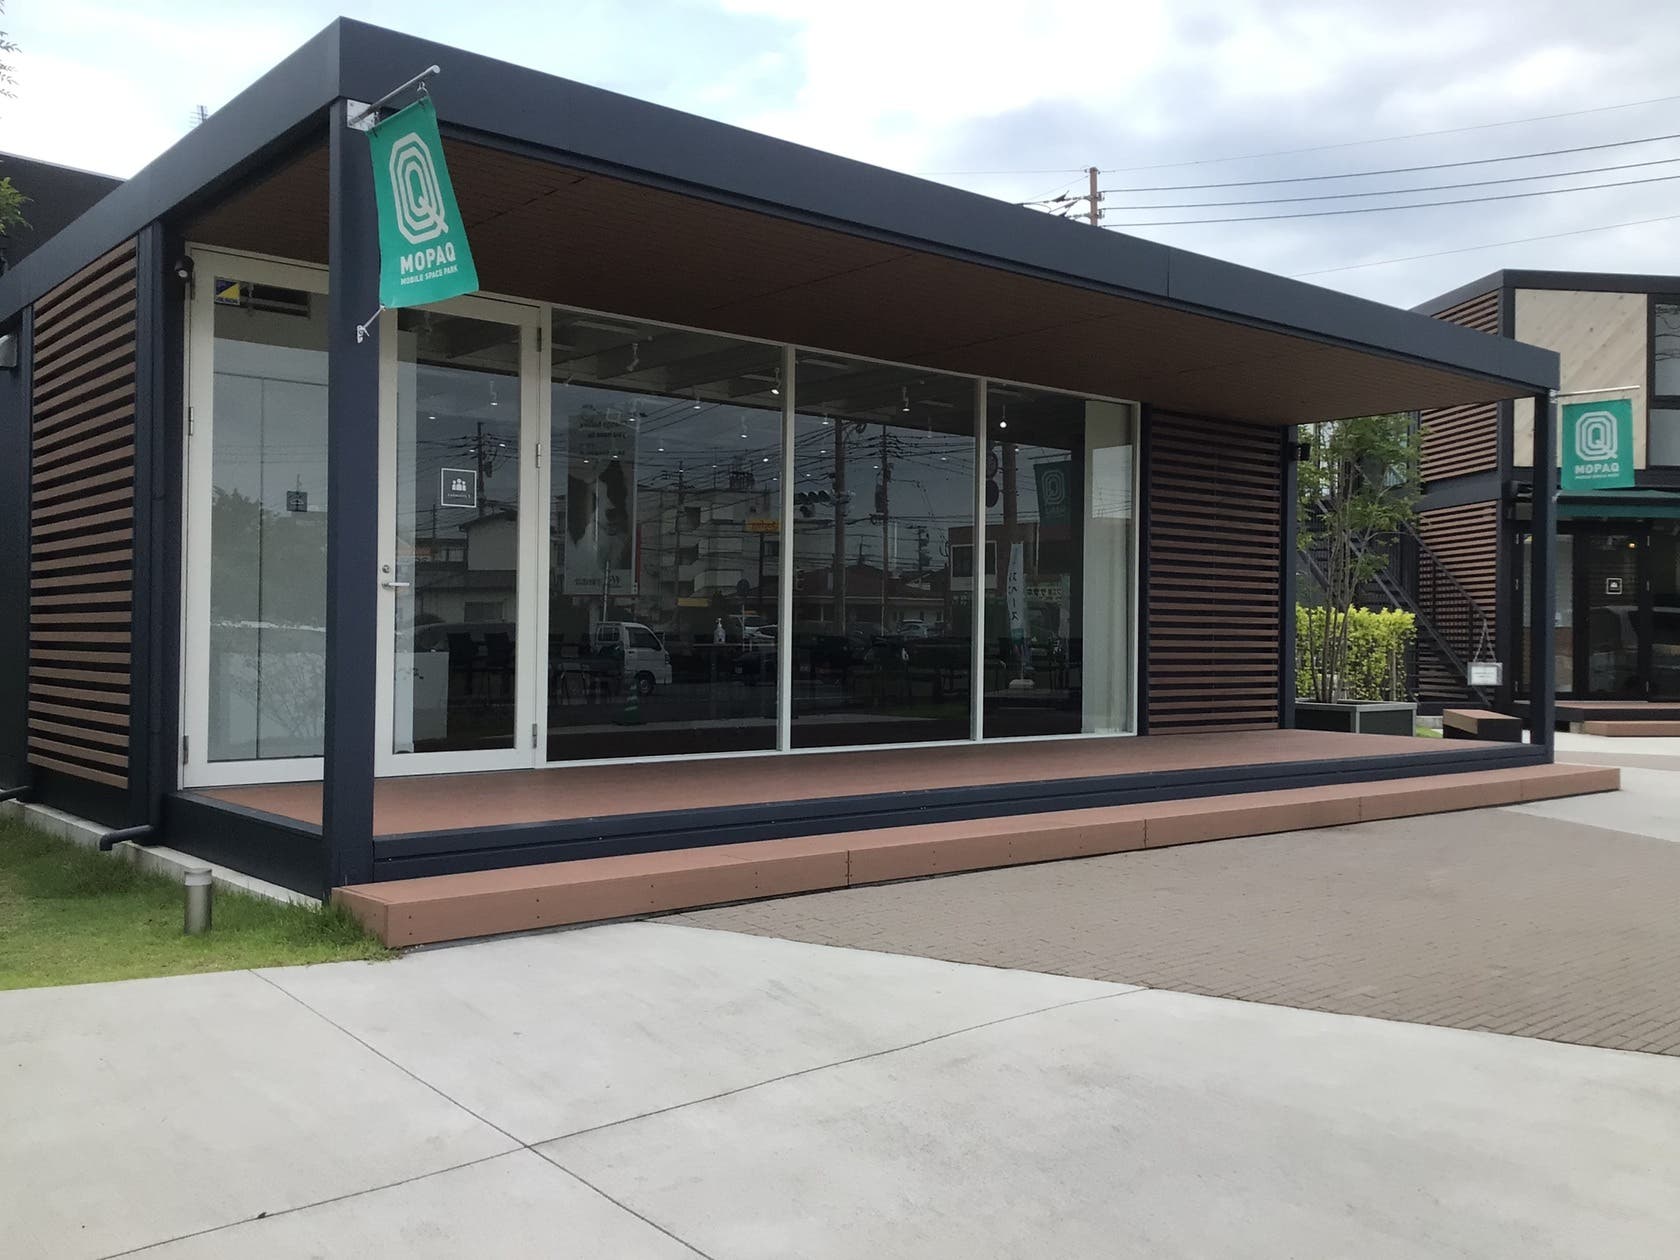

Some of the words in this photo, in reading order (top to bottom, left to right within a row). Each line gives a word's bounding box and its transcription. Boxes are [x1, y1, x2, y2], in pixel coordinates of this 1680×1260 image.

[400, 242, 456, 275] MOPAQ
[400, 273, 424, 285] MOBILE
[424, 268, 443, 280] SPACE
[443, 265, 458, 275] PARK
[1574, 462, 1620, 474] MOPAQ
